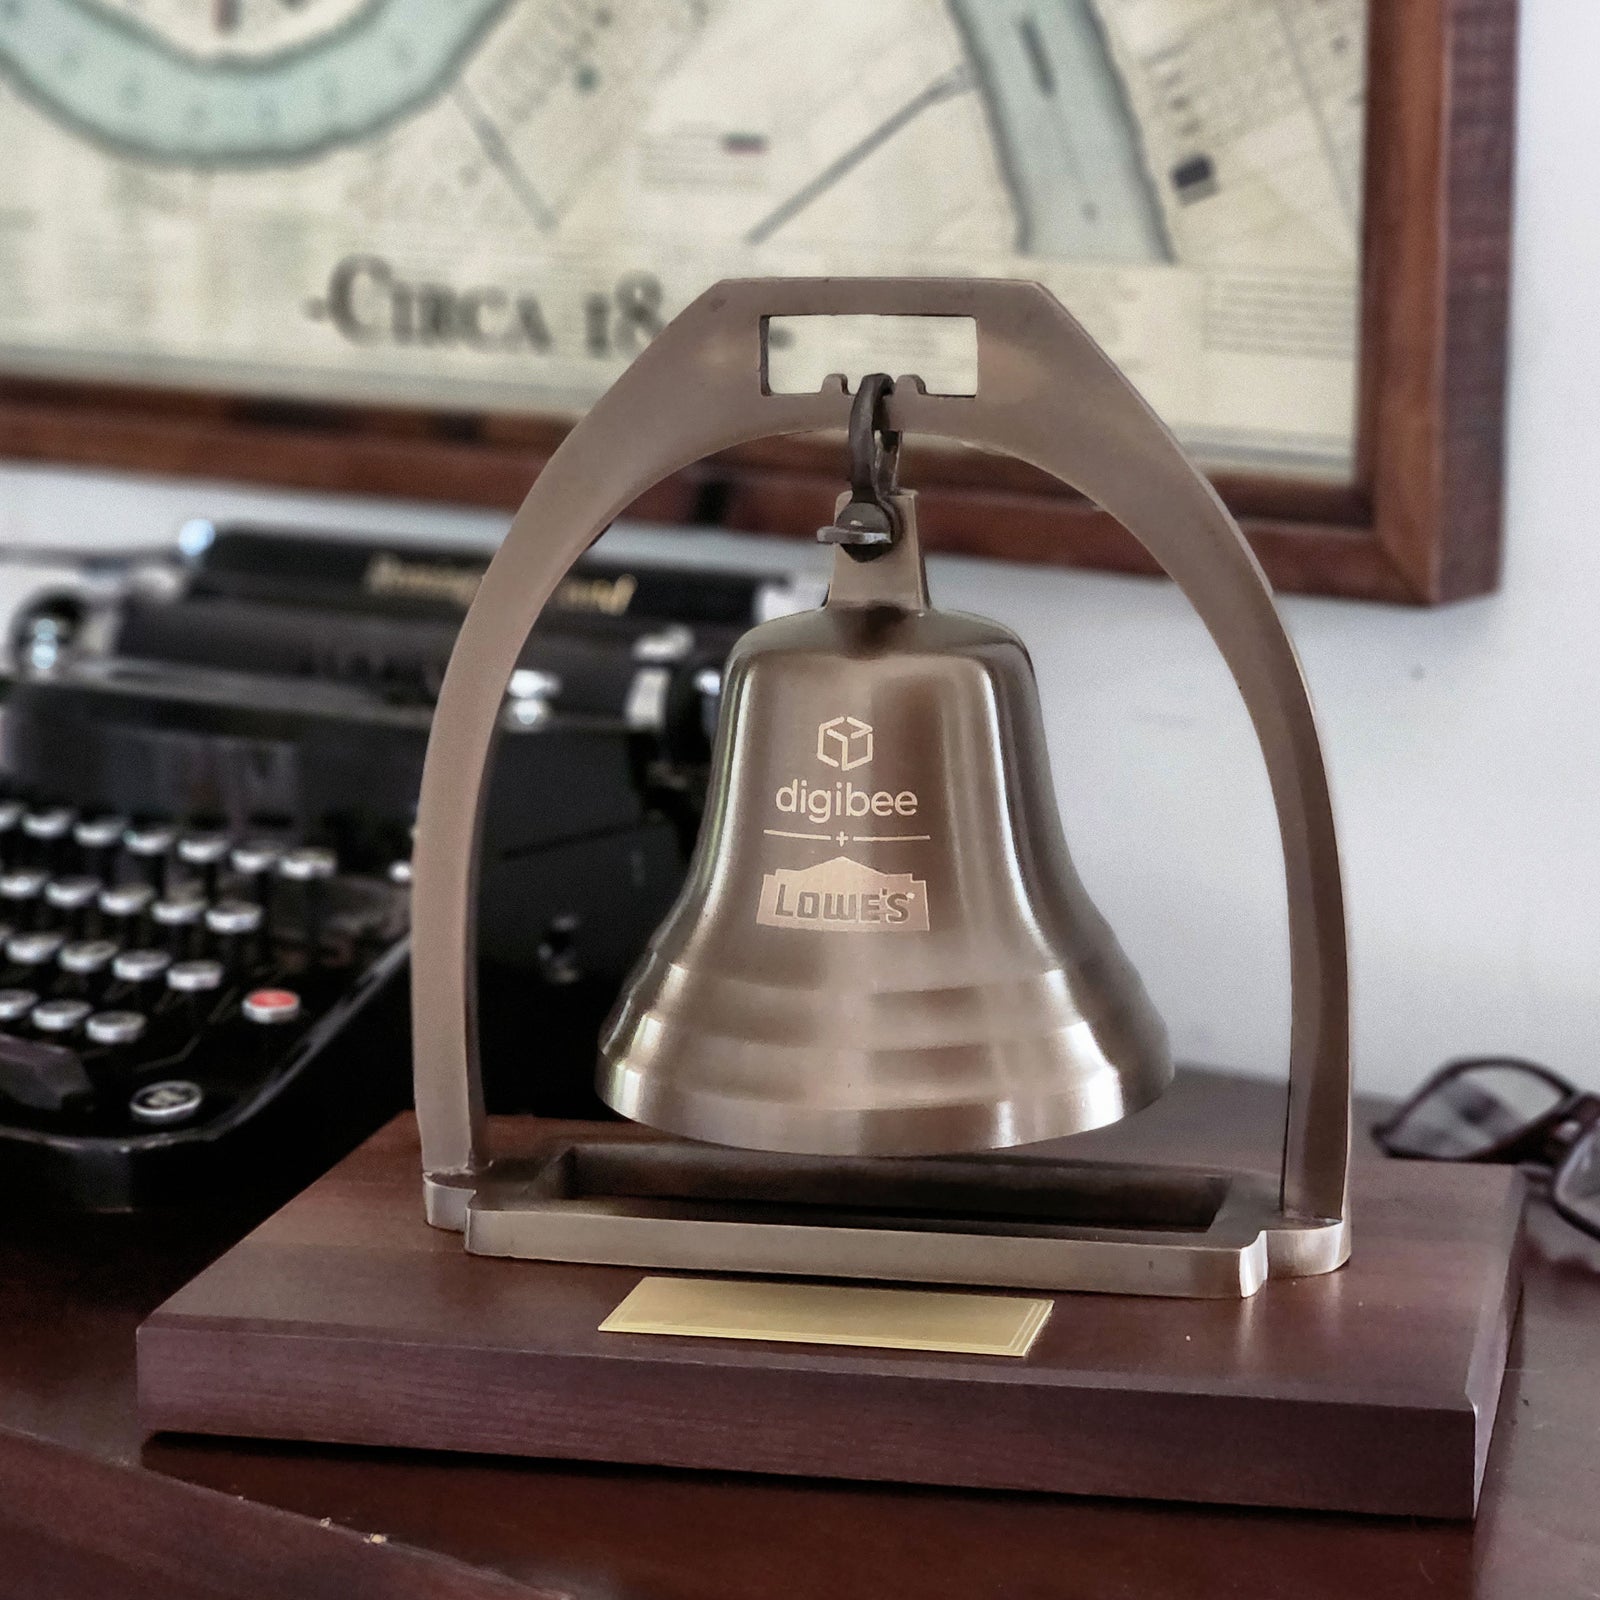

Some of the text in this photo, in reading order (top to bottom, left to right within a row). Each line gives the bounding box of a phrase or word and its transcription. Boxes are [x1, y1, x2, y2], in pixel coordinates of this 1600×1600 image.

[583, 271, 668, 360] 18
[775, 778, 919, 824] digibee
[774, 883, 911, 924] LOWE'S
